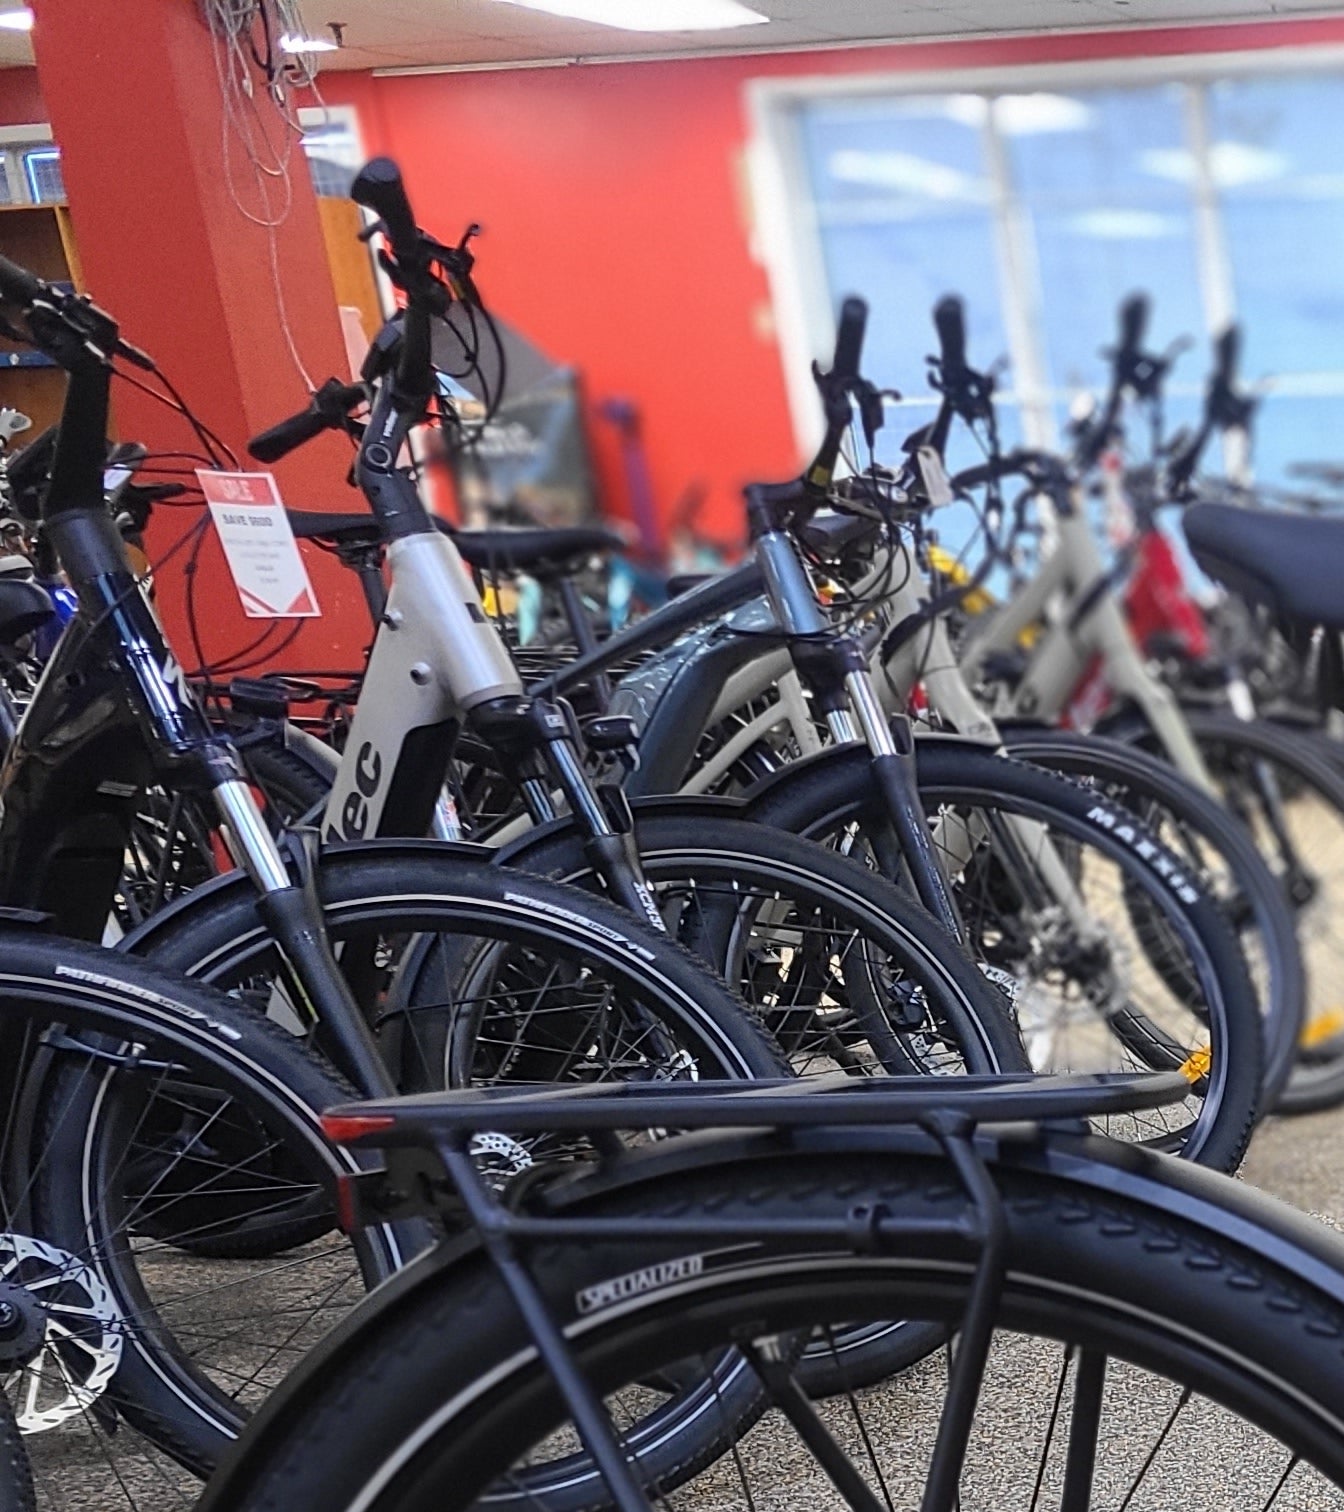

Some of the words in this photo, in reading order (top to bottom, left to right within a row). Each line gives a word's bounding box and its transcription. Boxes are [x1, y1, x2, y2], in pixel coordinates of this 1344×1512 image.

[222, 513, 248, 527] SAVE
[1086, 806, 1199, 905] MAXXIS
[583, 1254, 704, 1307] SPECIALIZED
